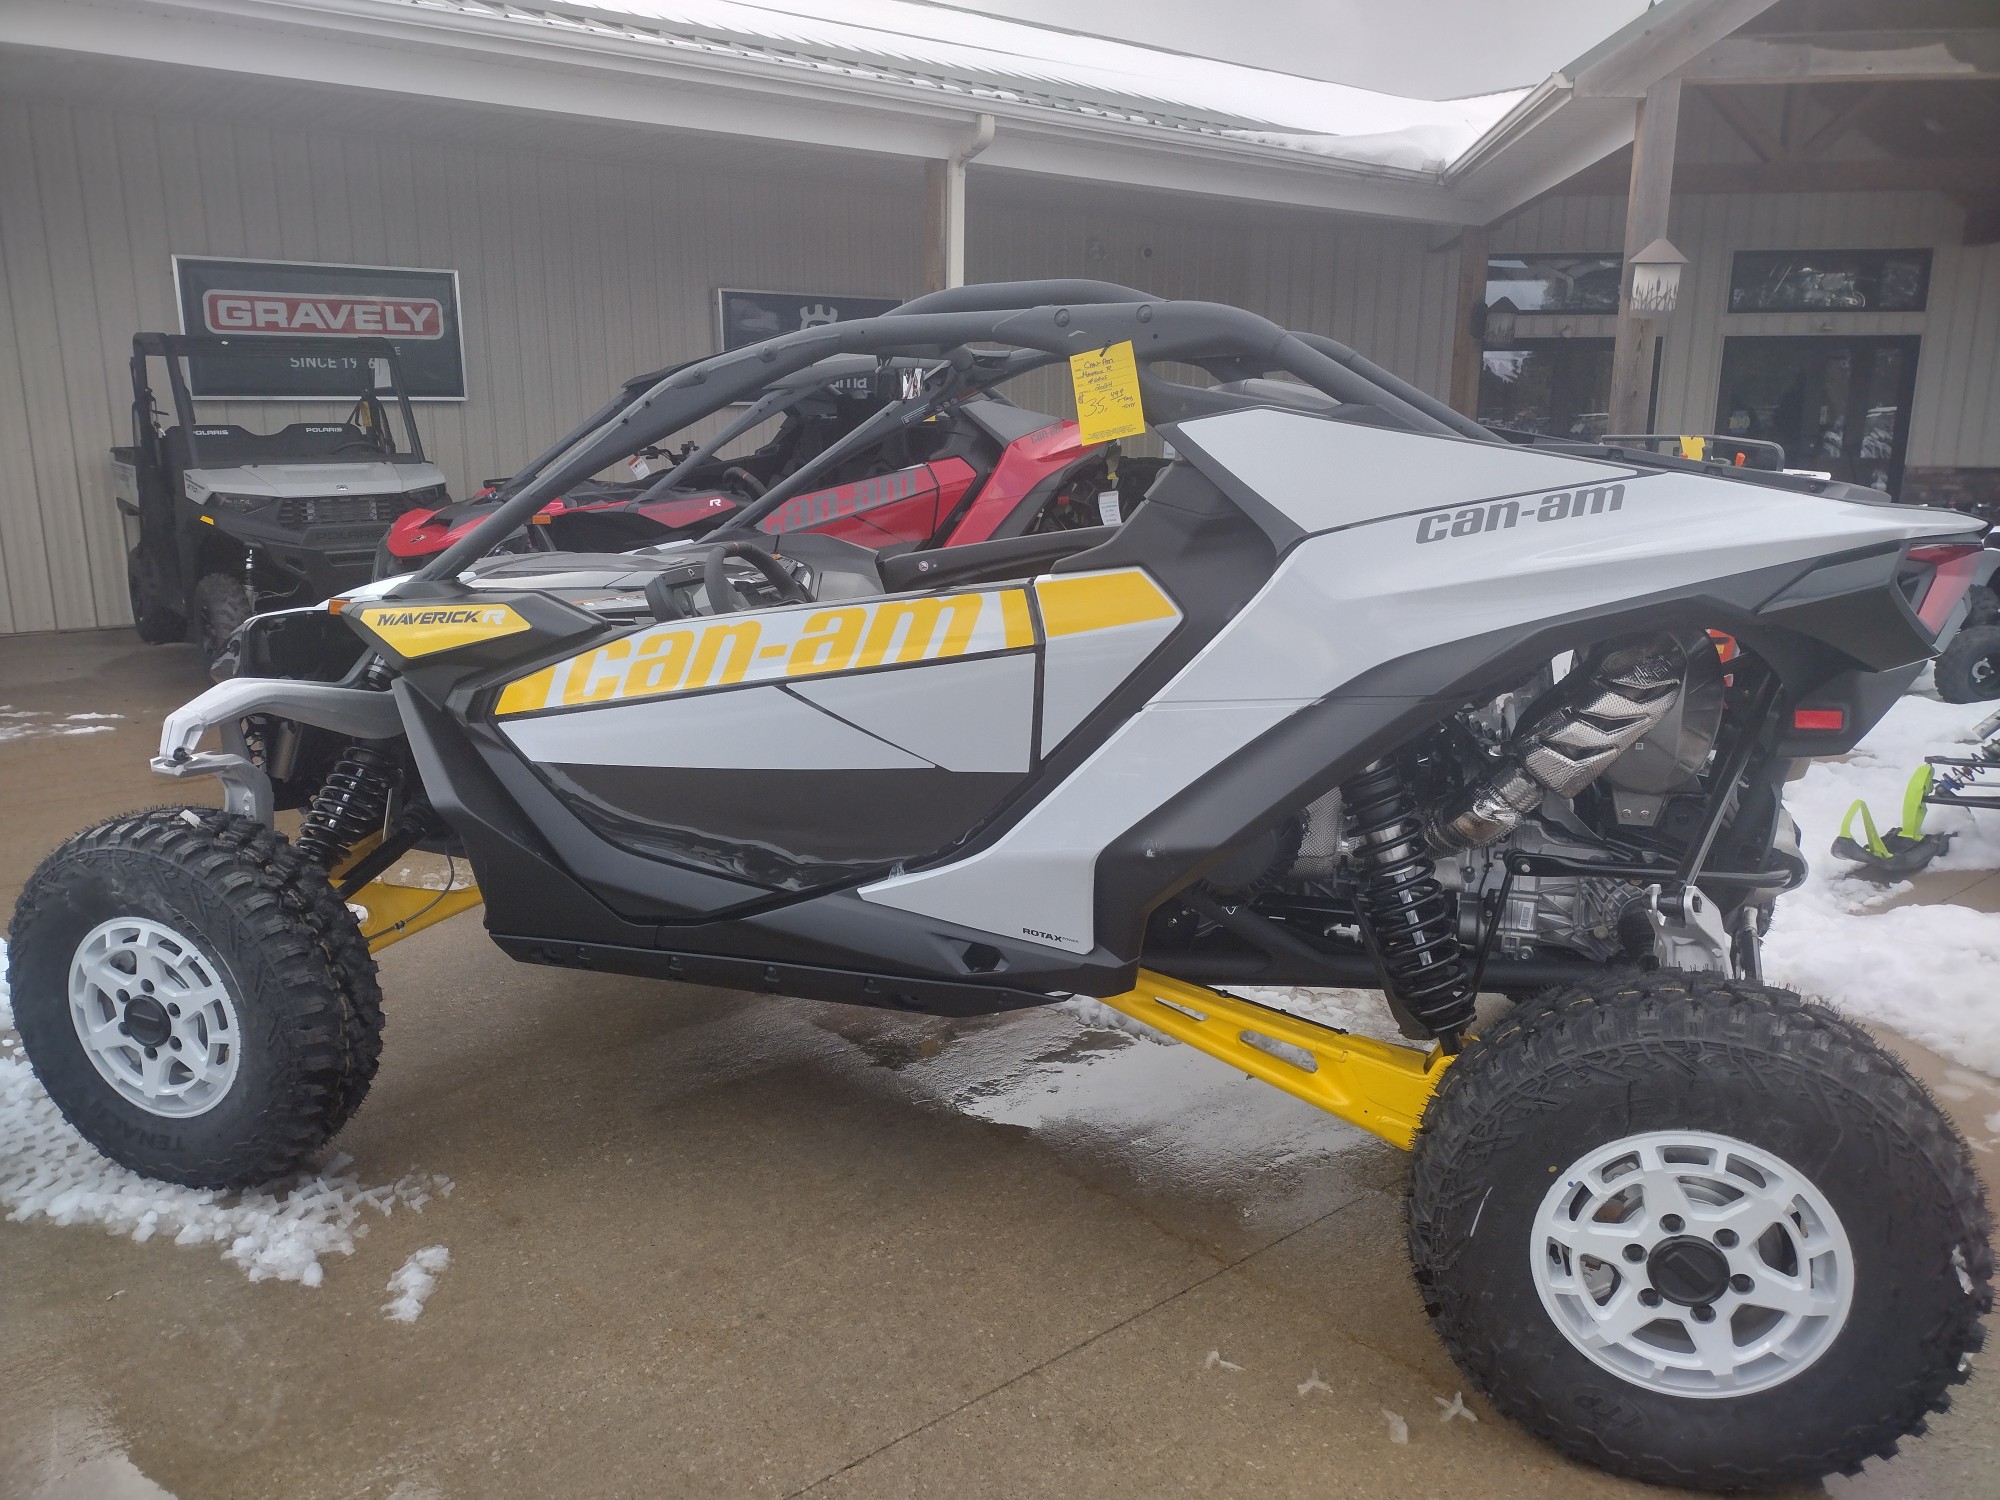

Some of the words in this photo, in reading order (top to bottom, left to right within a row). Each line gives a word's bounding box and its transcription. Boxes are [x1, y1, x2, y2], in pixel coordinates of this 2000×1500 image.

[216, 299, 433, 332] GRAVELY
[290, 357, 337, 369] SINCE
[341, 357, 375, 369] 196
[1415, 483, 1626, 545] can-am
[376, 610, 482, 627] MAVERICK
[482, 609, 507, 625] R
[562, 593, 983, 705] can-am
[1022, 927, 1062, 942] ROTAX
